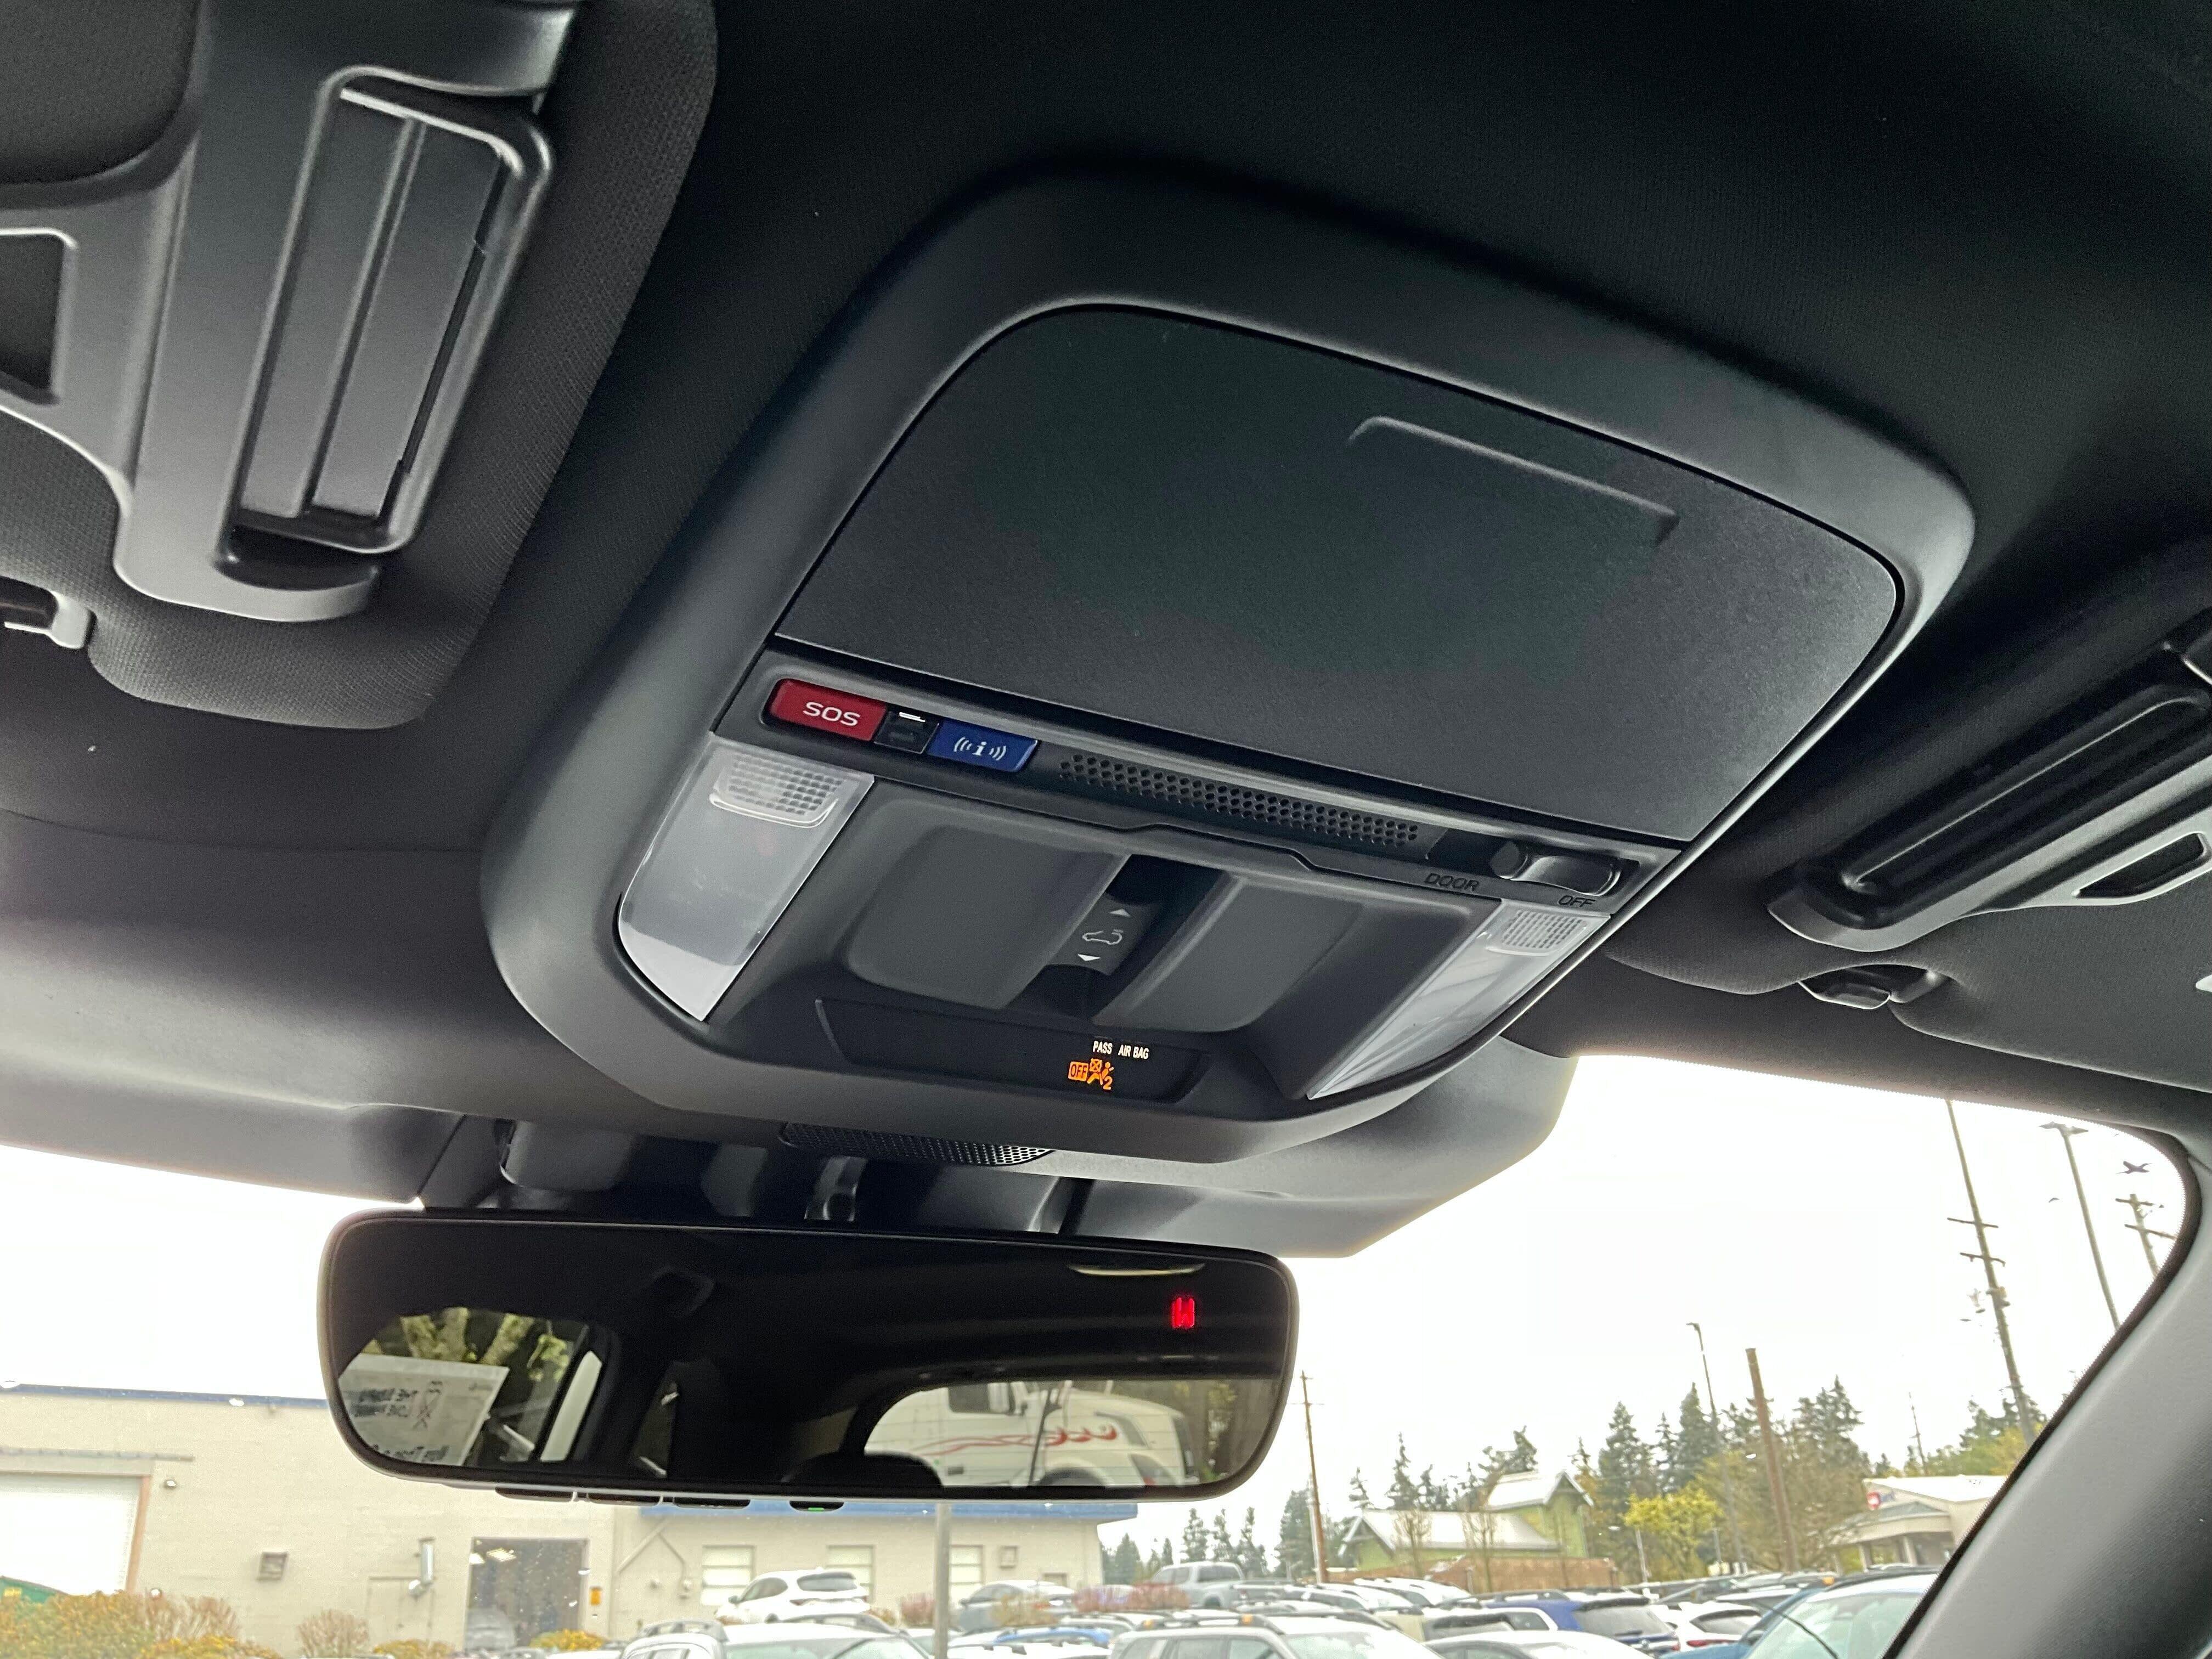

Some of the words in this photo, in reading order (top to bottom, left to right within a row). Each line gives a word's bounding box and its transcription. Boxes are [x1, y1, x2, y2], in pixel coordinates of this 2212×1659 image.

[803, 702, 860, 726] SOS
[1425, 873, 1479, 891] DOOR
[1558, 895, 1596, 908] OFF
[1093, 1041, 1113, 1054] PASS
[1118, 1045, 1131, 1057] AIR
[1133, 1046, 1149, 1059] BAG
[1070, 1064, 1087, 1079] OFF
[1103, 1076, 1113, 1090] 2
